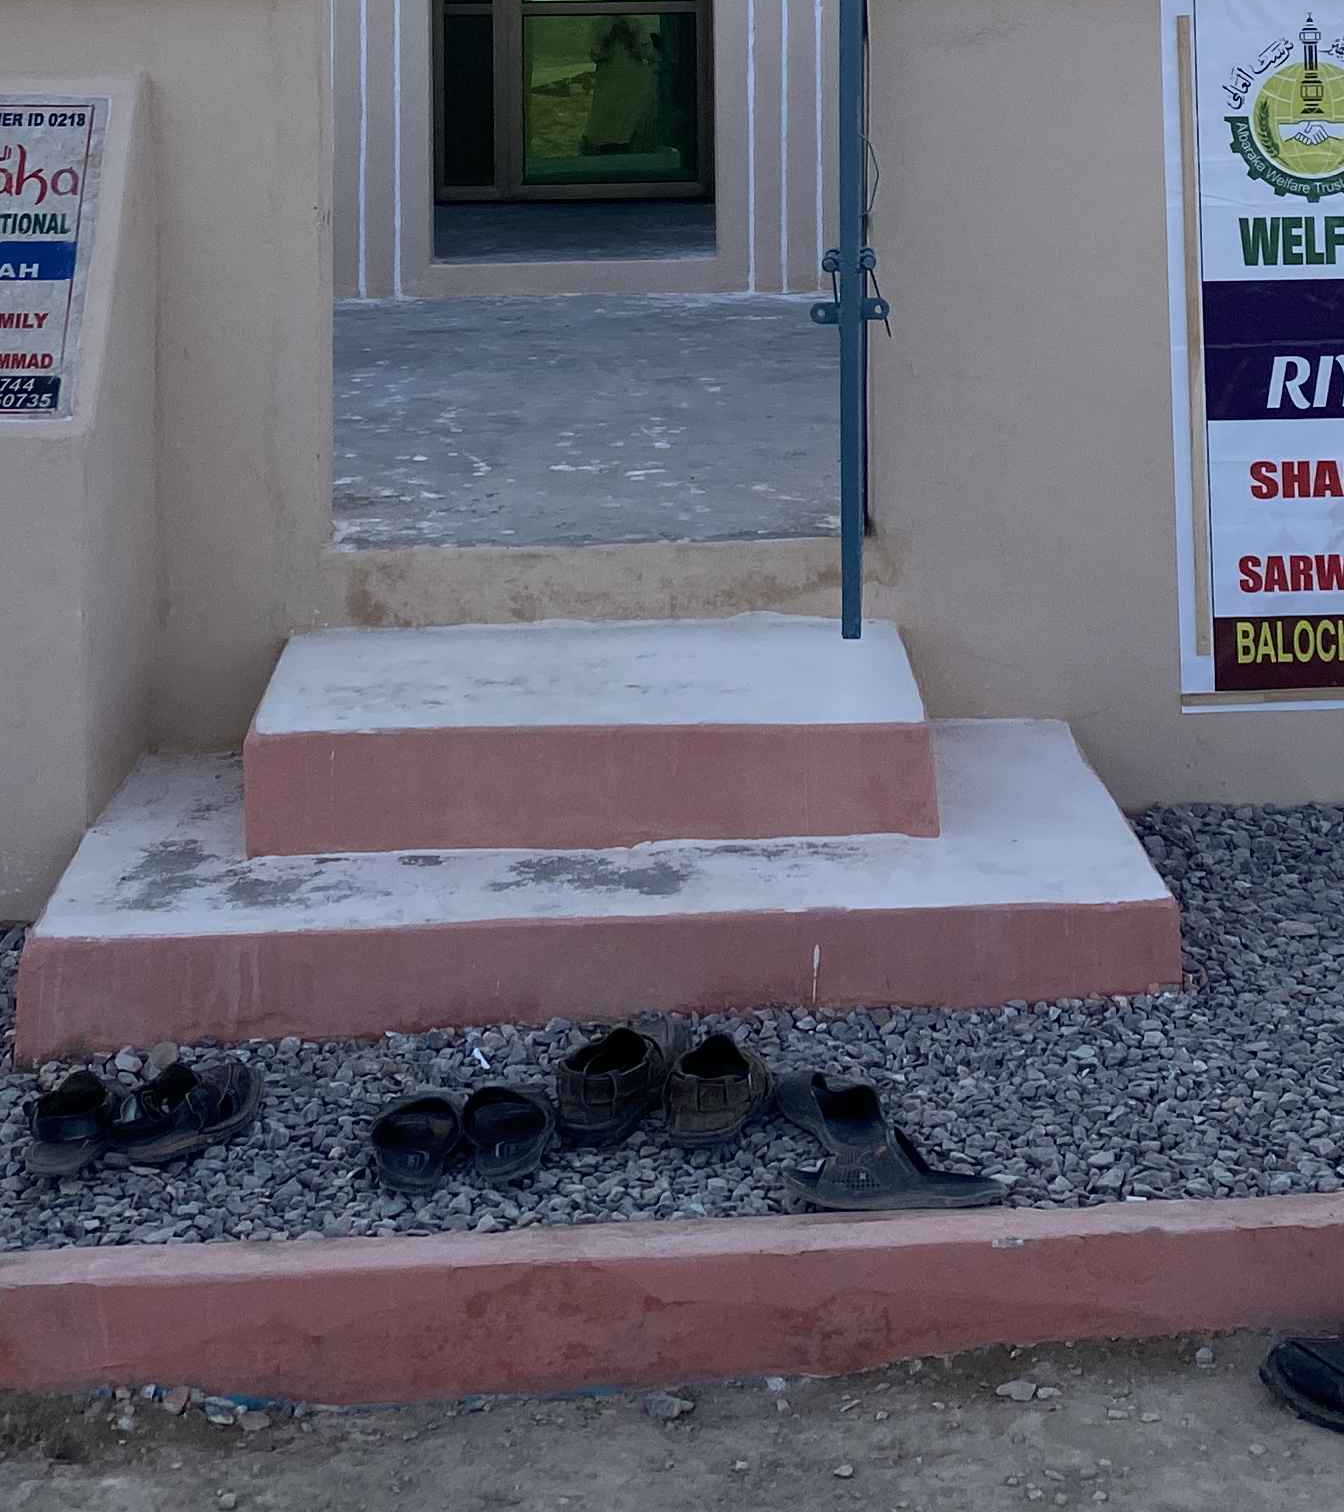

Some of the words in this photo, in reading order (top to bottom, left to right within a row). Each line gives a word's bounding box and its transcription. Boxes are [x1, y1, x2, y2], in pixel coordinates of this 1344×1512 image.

[28, 113, 44, 126] ID
[48, 113, 86, 127] 0218
[1235, 123, 1265, 172] Albaraka
[1265, 168, 1311, 194] Welfare
[1314, 179, 1344, 194] Trust
